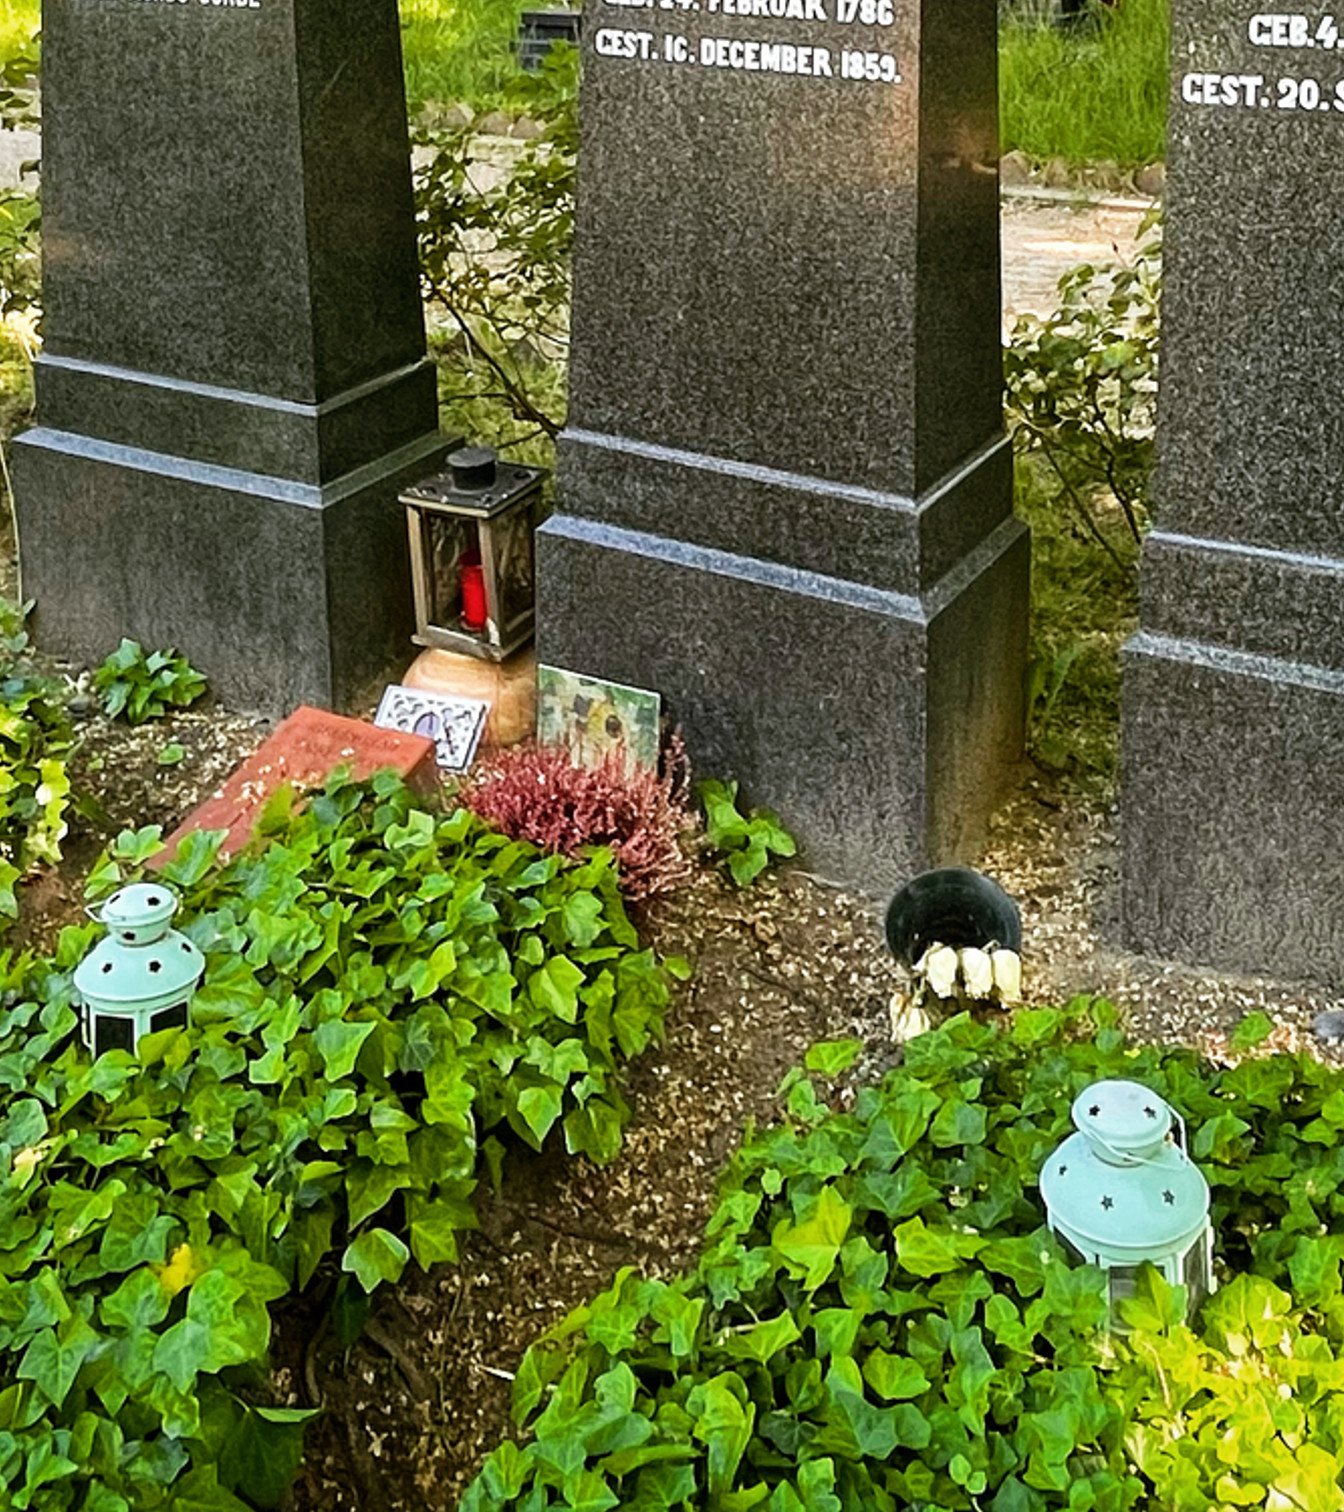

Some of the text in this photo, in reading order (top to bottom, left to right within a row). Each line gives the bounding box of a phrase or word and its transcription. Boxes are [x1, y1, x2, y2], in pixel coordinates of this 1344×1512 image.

[700, 38, 833, 77] DECEMBER
[841, 50, 902, 84] 1859.
[1276, 77, 1328, 110] 20.
